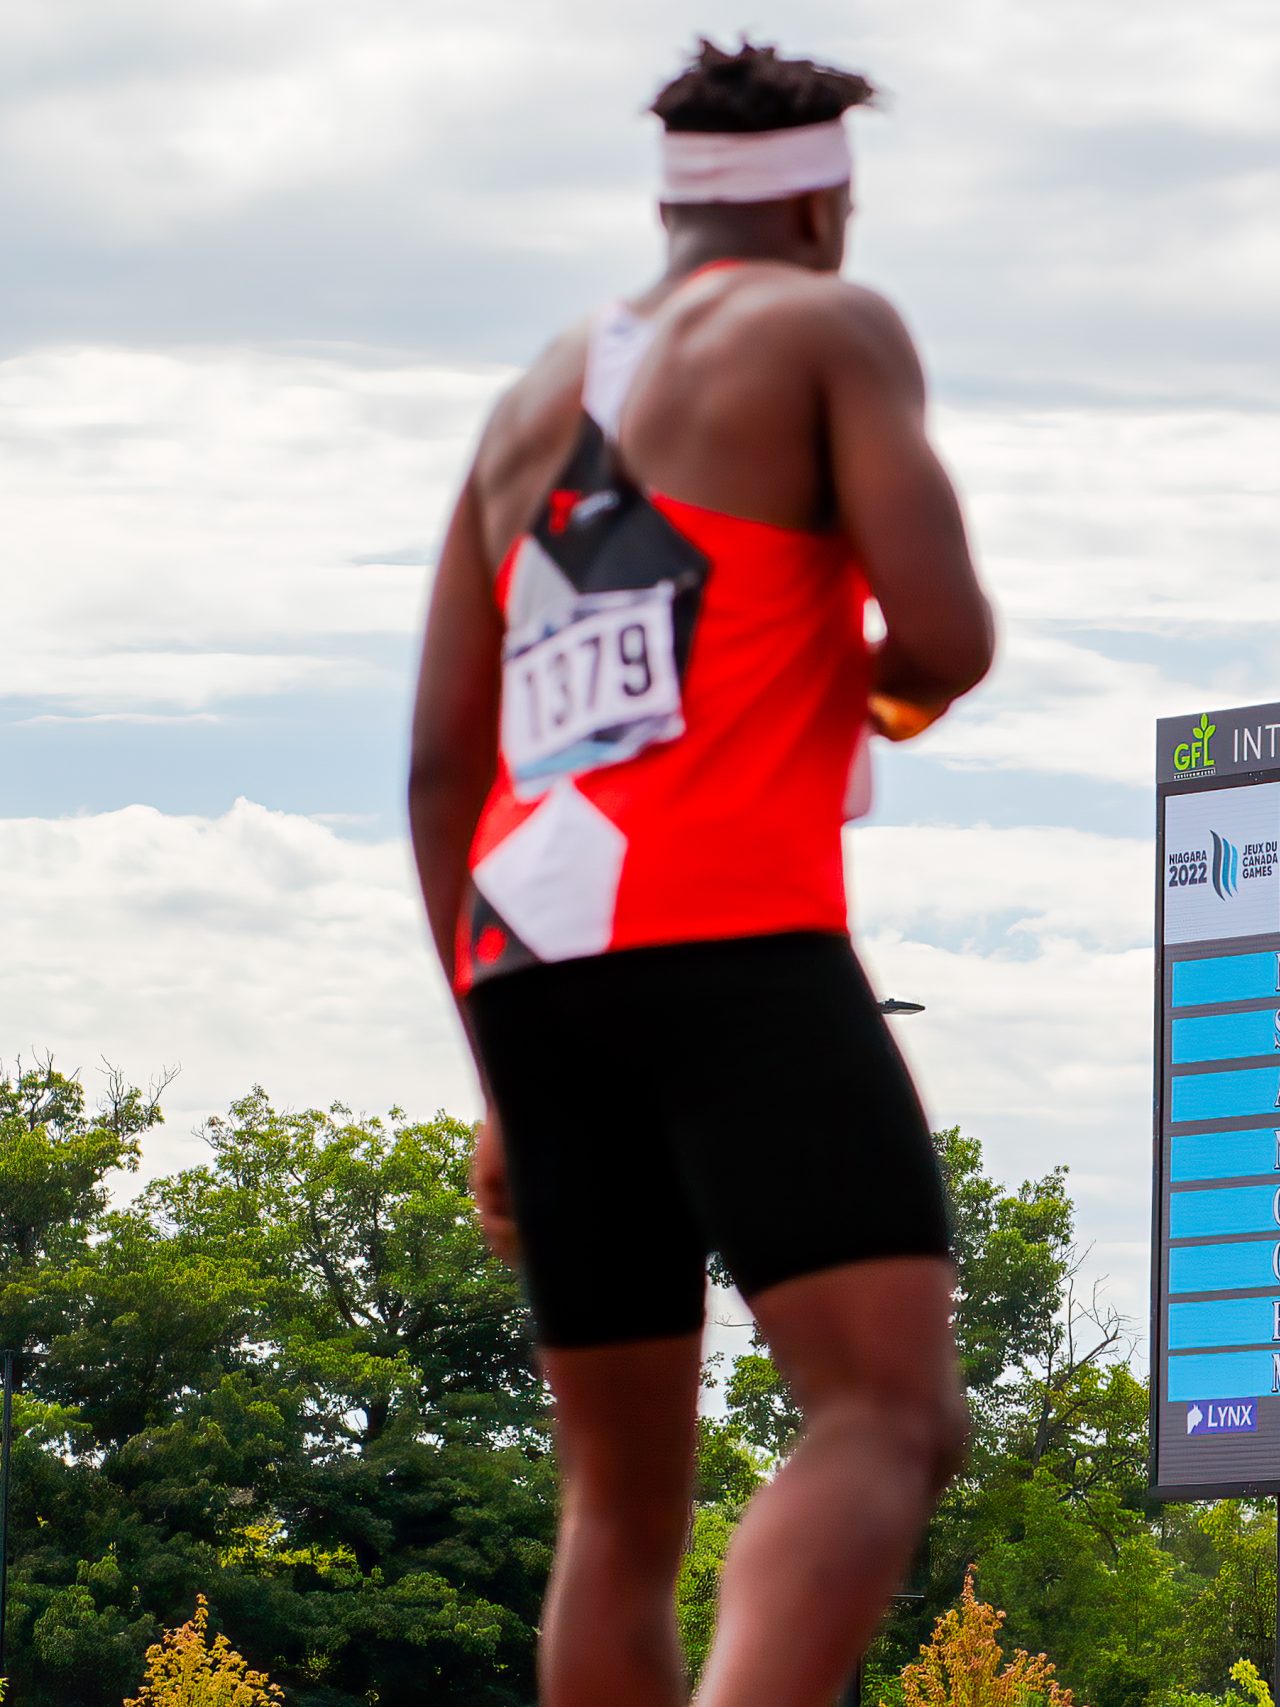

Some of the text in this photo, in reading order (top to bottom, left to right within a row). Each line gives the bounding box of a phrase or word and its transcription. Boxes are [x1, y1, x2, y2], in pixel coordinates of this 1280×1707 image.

[1173, 713, 1216, 771] GFL
[1242, 841, 1278, 856] JEUX DU
[1169, 850, 1208, 865] NIAGARA
[1242, 853, 1279, 868] CANADA
[1168, 862, 1208, 888] 2022
[1242, 865, 1273, 879] GAMES
[1207, 1404, 1252, 1428] LYNX
